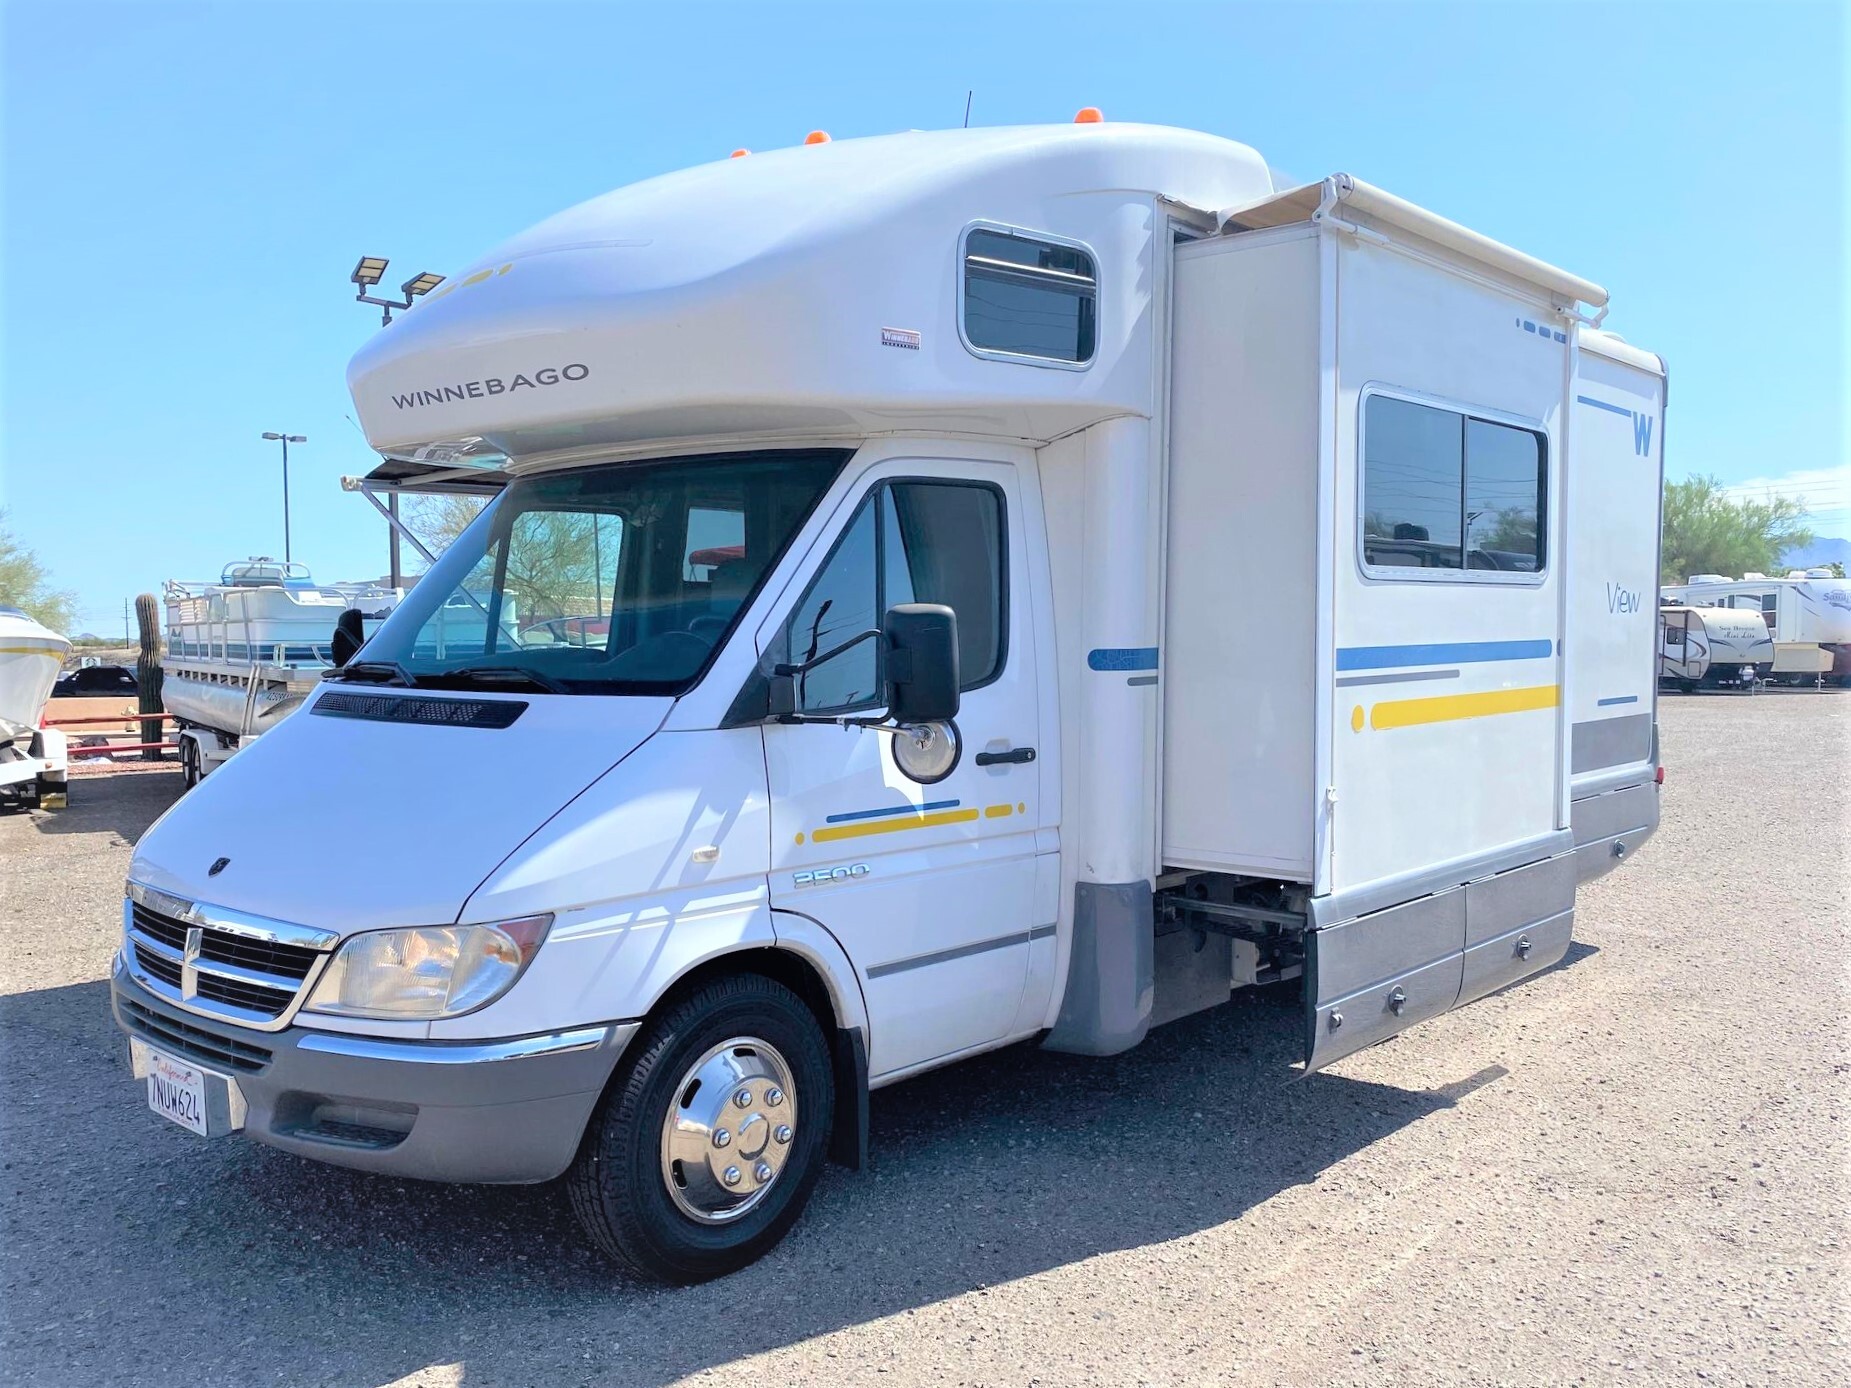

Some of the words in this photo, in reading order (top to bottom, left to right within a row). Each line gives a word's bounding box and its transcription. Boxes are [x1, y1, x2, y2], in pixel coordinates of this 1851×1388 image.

[391, 363, 590, 410] WINNEBAGO
[1632, 411, 1653, 457] W
[1606, 581, 1641, 613] View
[150, 1073, 201, 1125] 7NUW624
